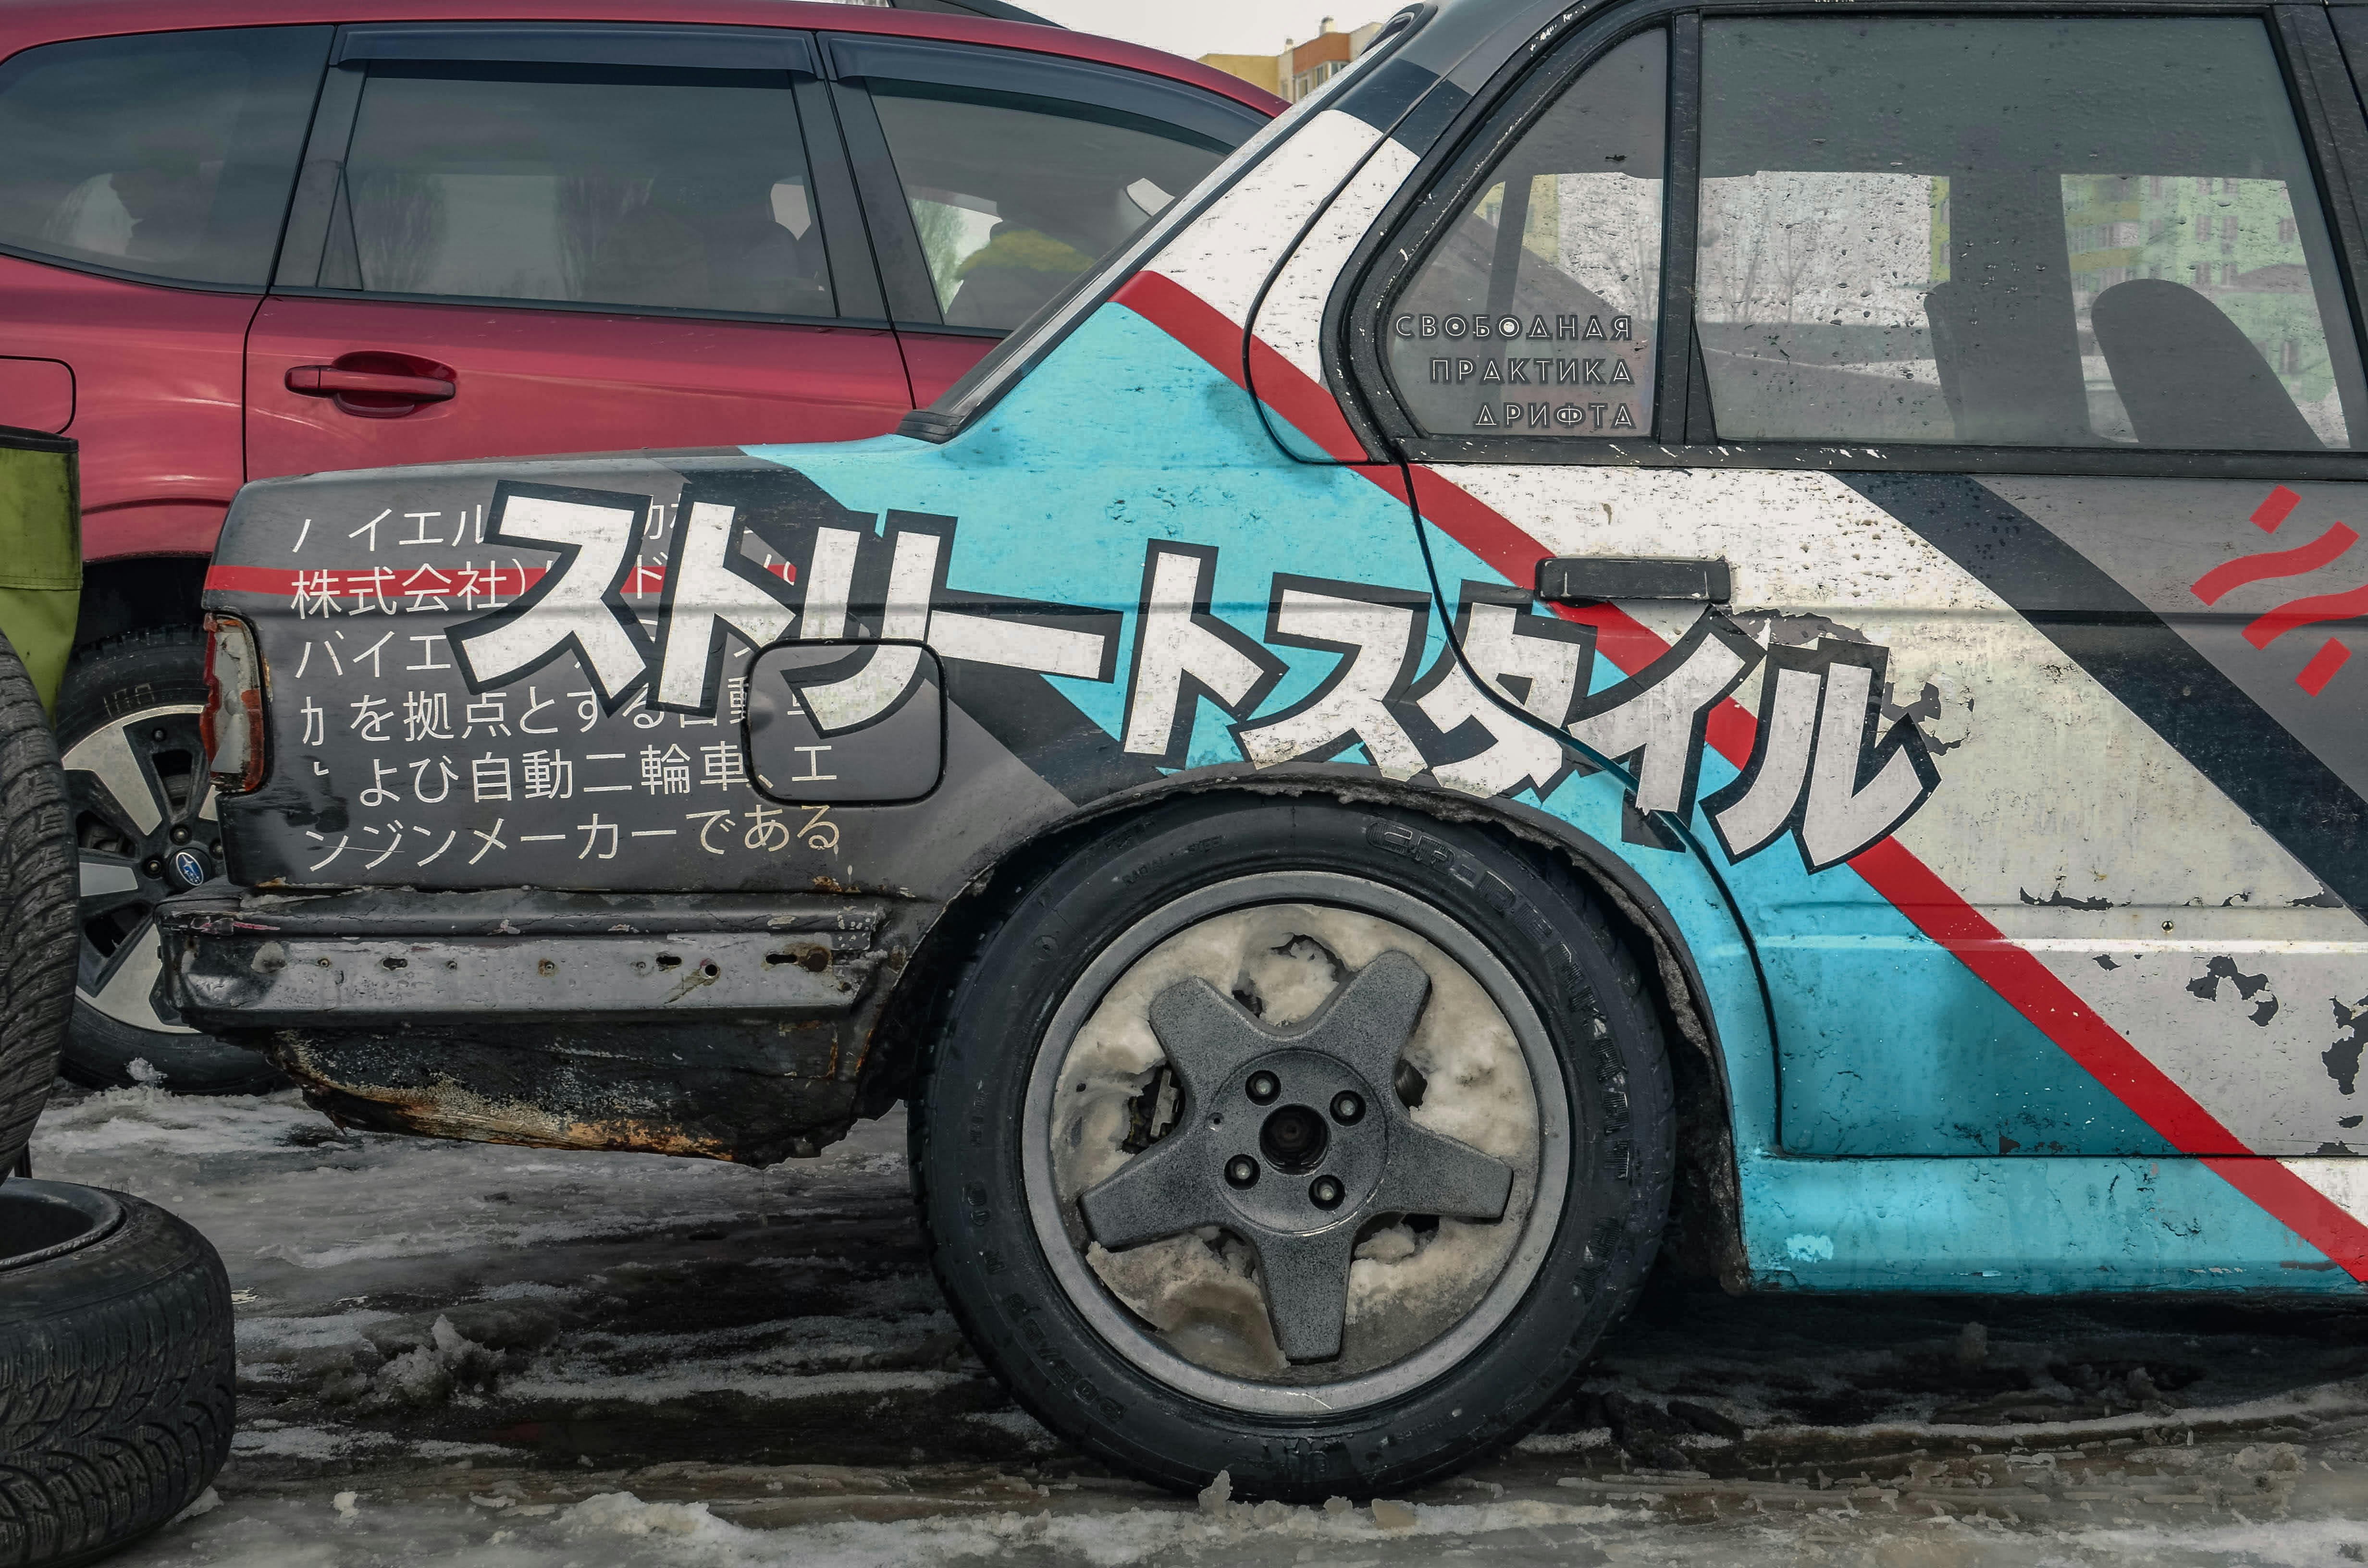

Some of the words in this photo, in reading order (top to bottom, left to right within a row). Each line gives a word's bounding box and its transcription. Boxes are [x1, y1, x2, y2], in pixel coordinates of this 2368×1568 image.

[1393, 314, 1632, 341] СВОБОДНАЯ
[1430, 357, 1635, 385] ПРАКТИКА
[1473, 401, 1636, 429] ДРИФТА
[461, 495, 1924, 867] ストリートスタイル
[313, 740, 837, 807] よび自動二輪車、エ
[306, 804, 840, 872] ンジンメーカーである
